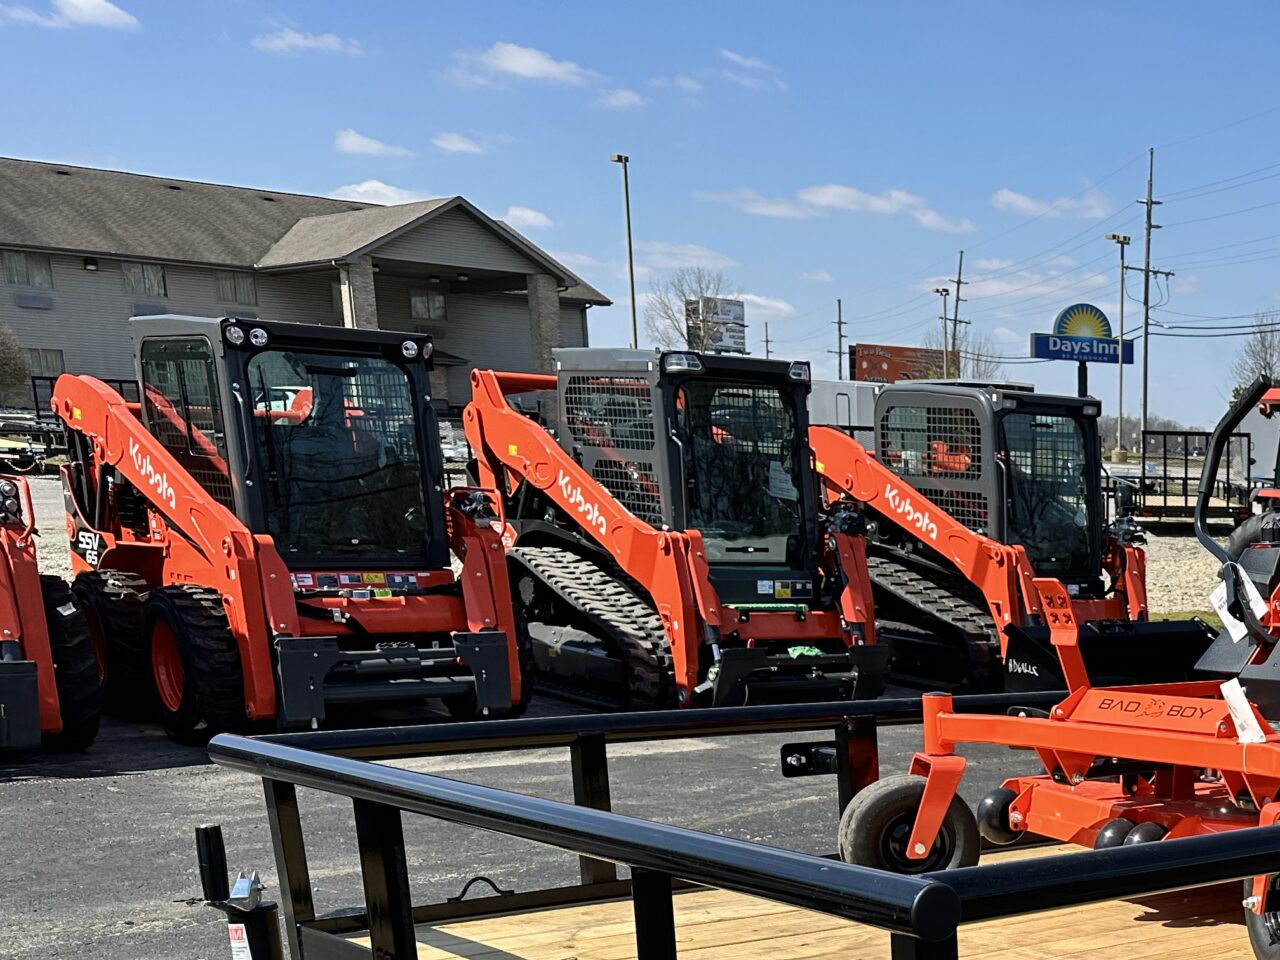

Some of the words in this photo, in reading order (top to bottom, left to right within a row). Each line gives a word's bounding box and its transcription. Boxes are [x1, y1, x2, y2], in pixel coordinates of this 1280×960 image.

[857, 346, 875, 357] Two
[1048, 337, 1090, 354] Days
[1093, 340, 1119, 355] Inn
[129, 437, 175, 510] Kubota
[559, 470, 606, 536] Kubota
[885, 483, 938, 541] Kubota
[79, 531, 100, 550] SSV
[85, 549, 98, 564] 65
[1098, 698, 1141, 713] BAD
[1166, 705, 1214, 719] BOY
